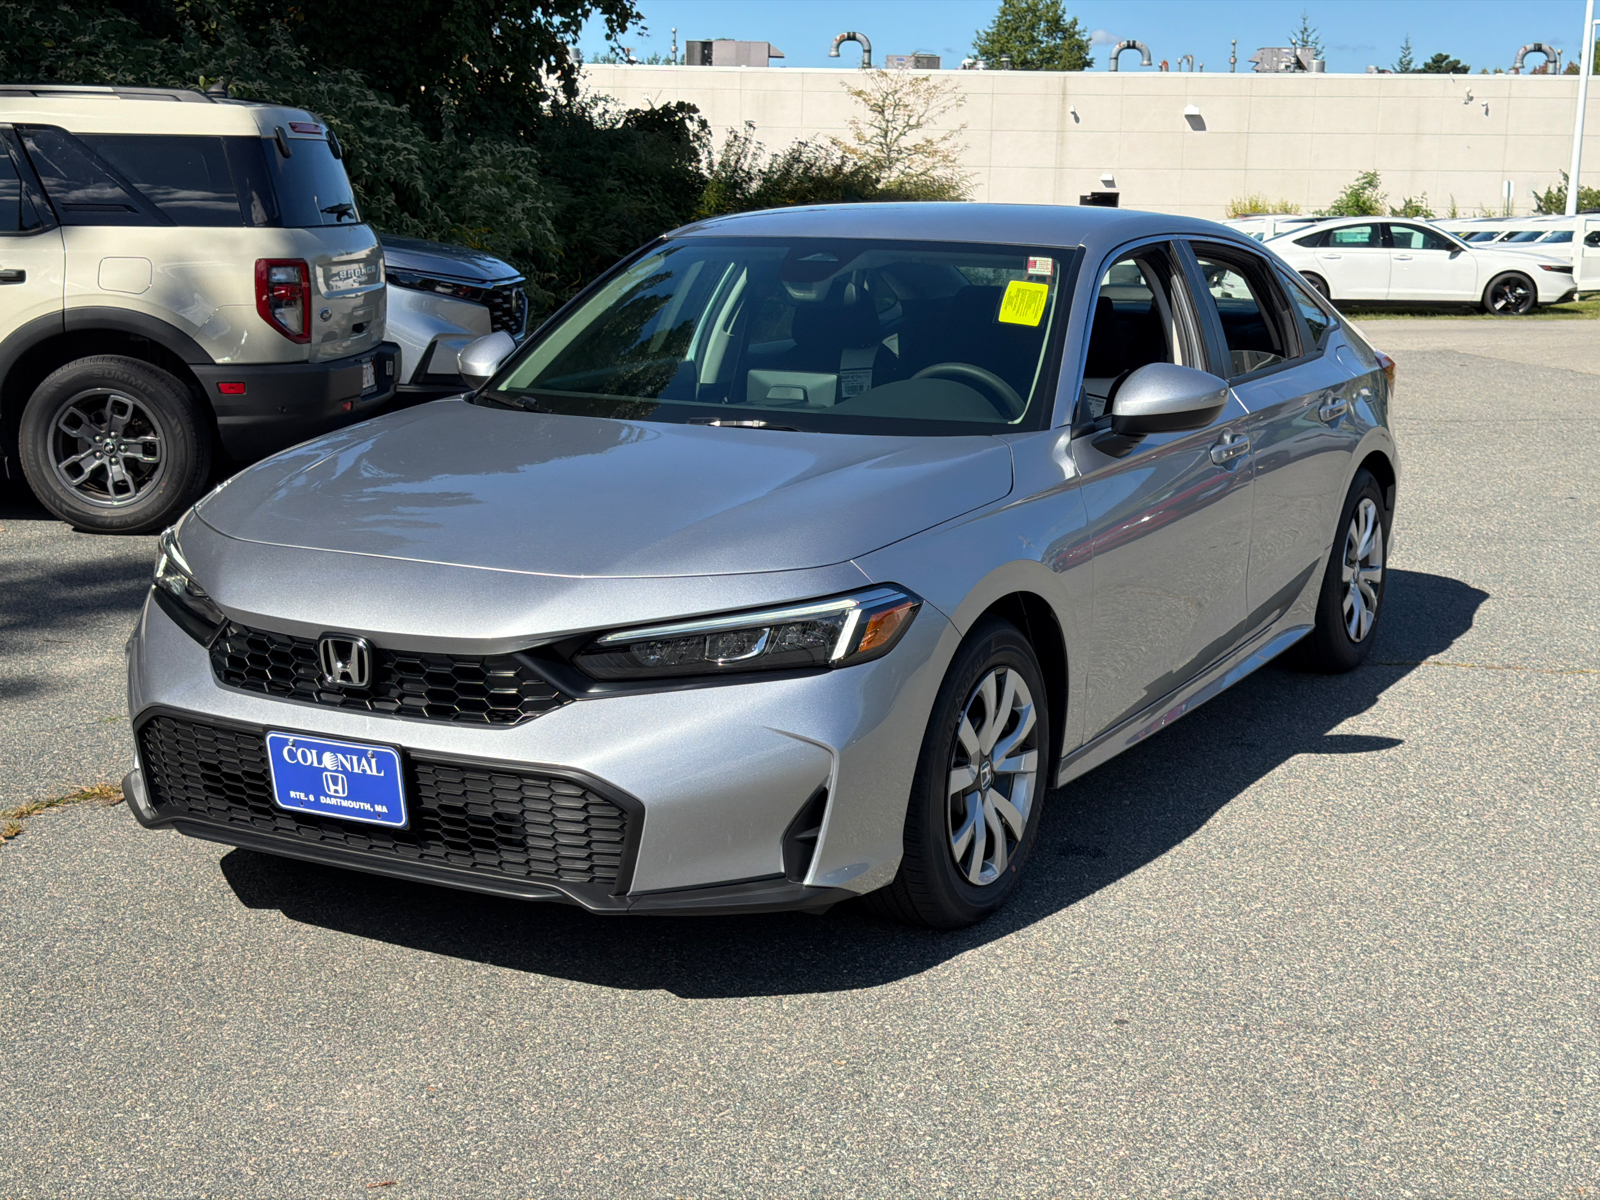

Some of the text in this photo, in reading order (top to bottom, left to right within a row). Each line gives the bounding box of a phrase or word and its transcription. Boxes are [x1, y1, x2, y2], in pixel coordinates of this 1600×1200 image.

[339, 265, 376, 278] BRONCO
[93, 368, 156, 394] SUMMIT
[282, 745, 385, 777] COLONIAL
[289, 790, 389, 813] RTE. 6 DARTMOUTH, MA
